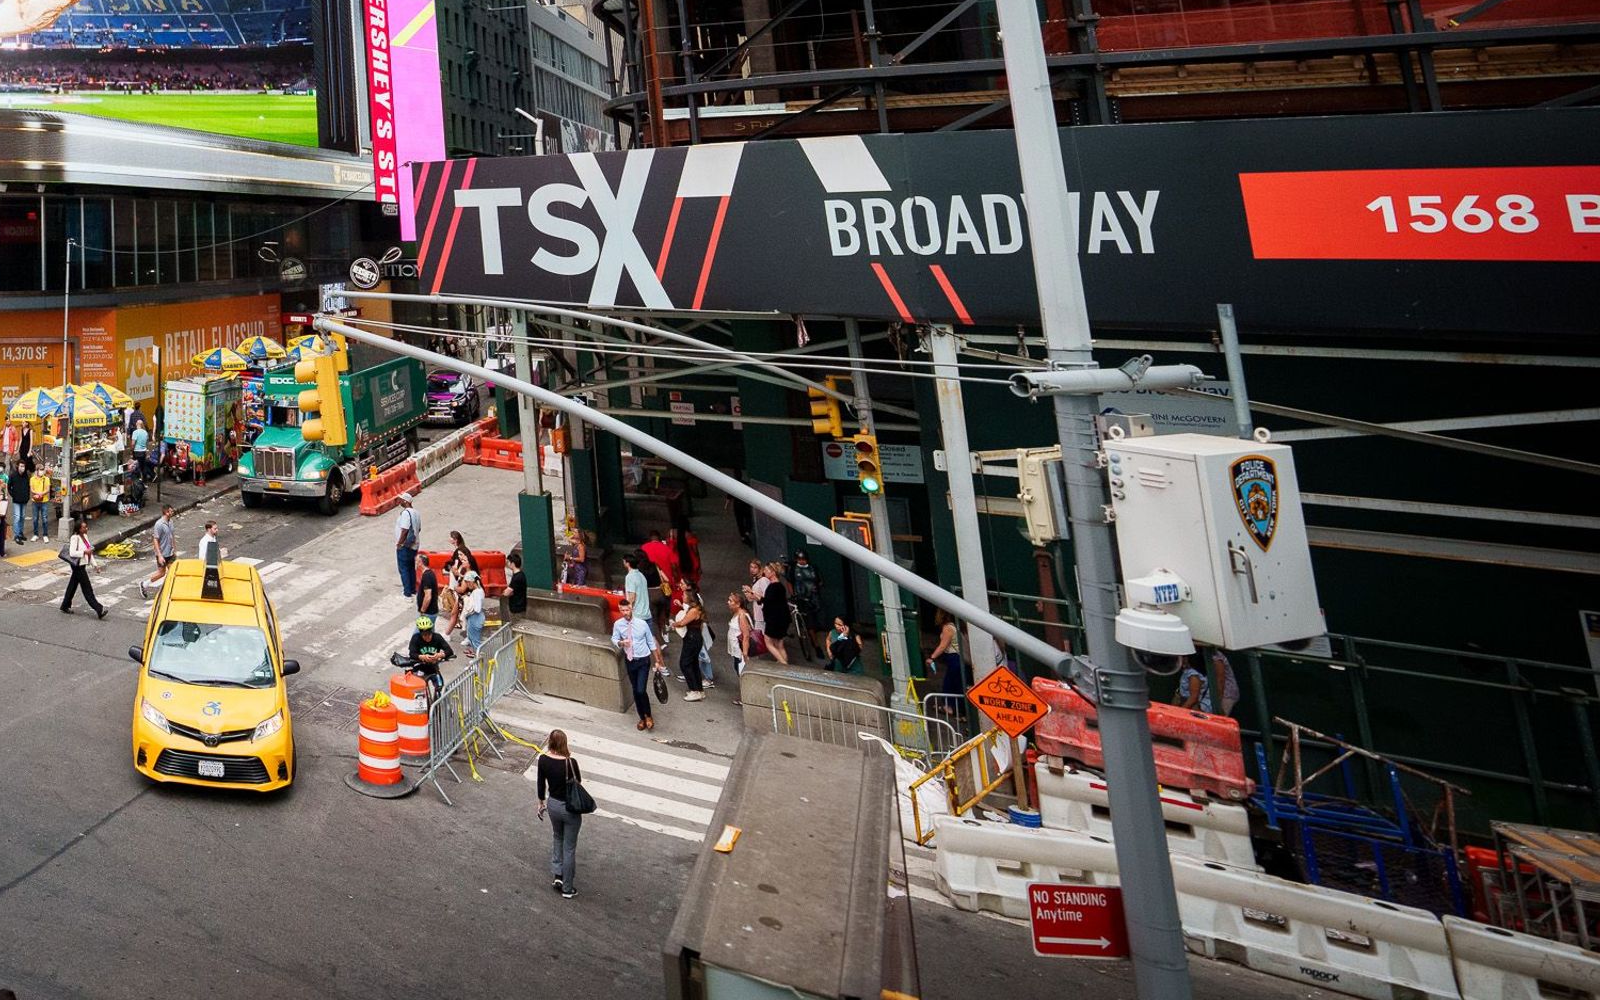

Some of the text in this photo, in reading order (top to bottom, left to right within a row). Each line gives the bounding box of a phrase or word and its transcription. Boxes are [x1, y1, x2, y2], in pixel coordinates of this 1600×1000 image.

[1365, 194, 1540, 234] 1568
[453, 148, 675, 310] TSX
[823, 190, 1160, 257] BROADAY
[2, 346, 48, 363] 14,370 SF
[2, 390, 20, 398] 705
[129, 385, 140, 395] 7TH
[1171, 415, 1226, 424] McGOVERN
[1241, 460, 1265, 472] POLICE
[1235, 469, 1275, 488] DEPARTMENT
[1239, 498, 1251, 520] CITY
[1249, 522, 1258, 534] OF
[1154, 584, 1179, 603] NYPD
[983, 696, 1035, 713] WORK ZONE
[996, 712, 1025, 724] AHEAD
[1033, 890, 1107, 907] NO STANDING
[1036, 907, 1083, 924] Anytime
[1299, 965, 1340, 983] YODOCK
